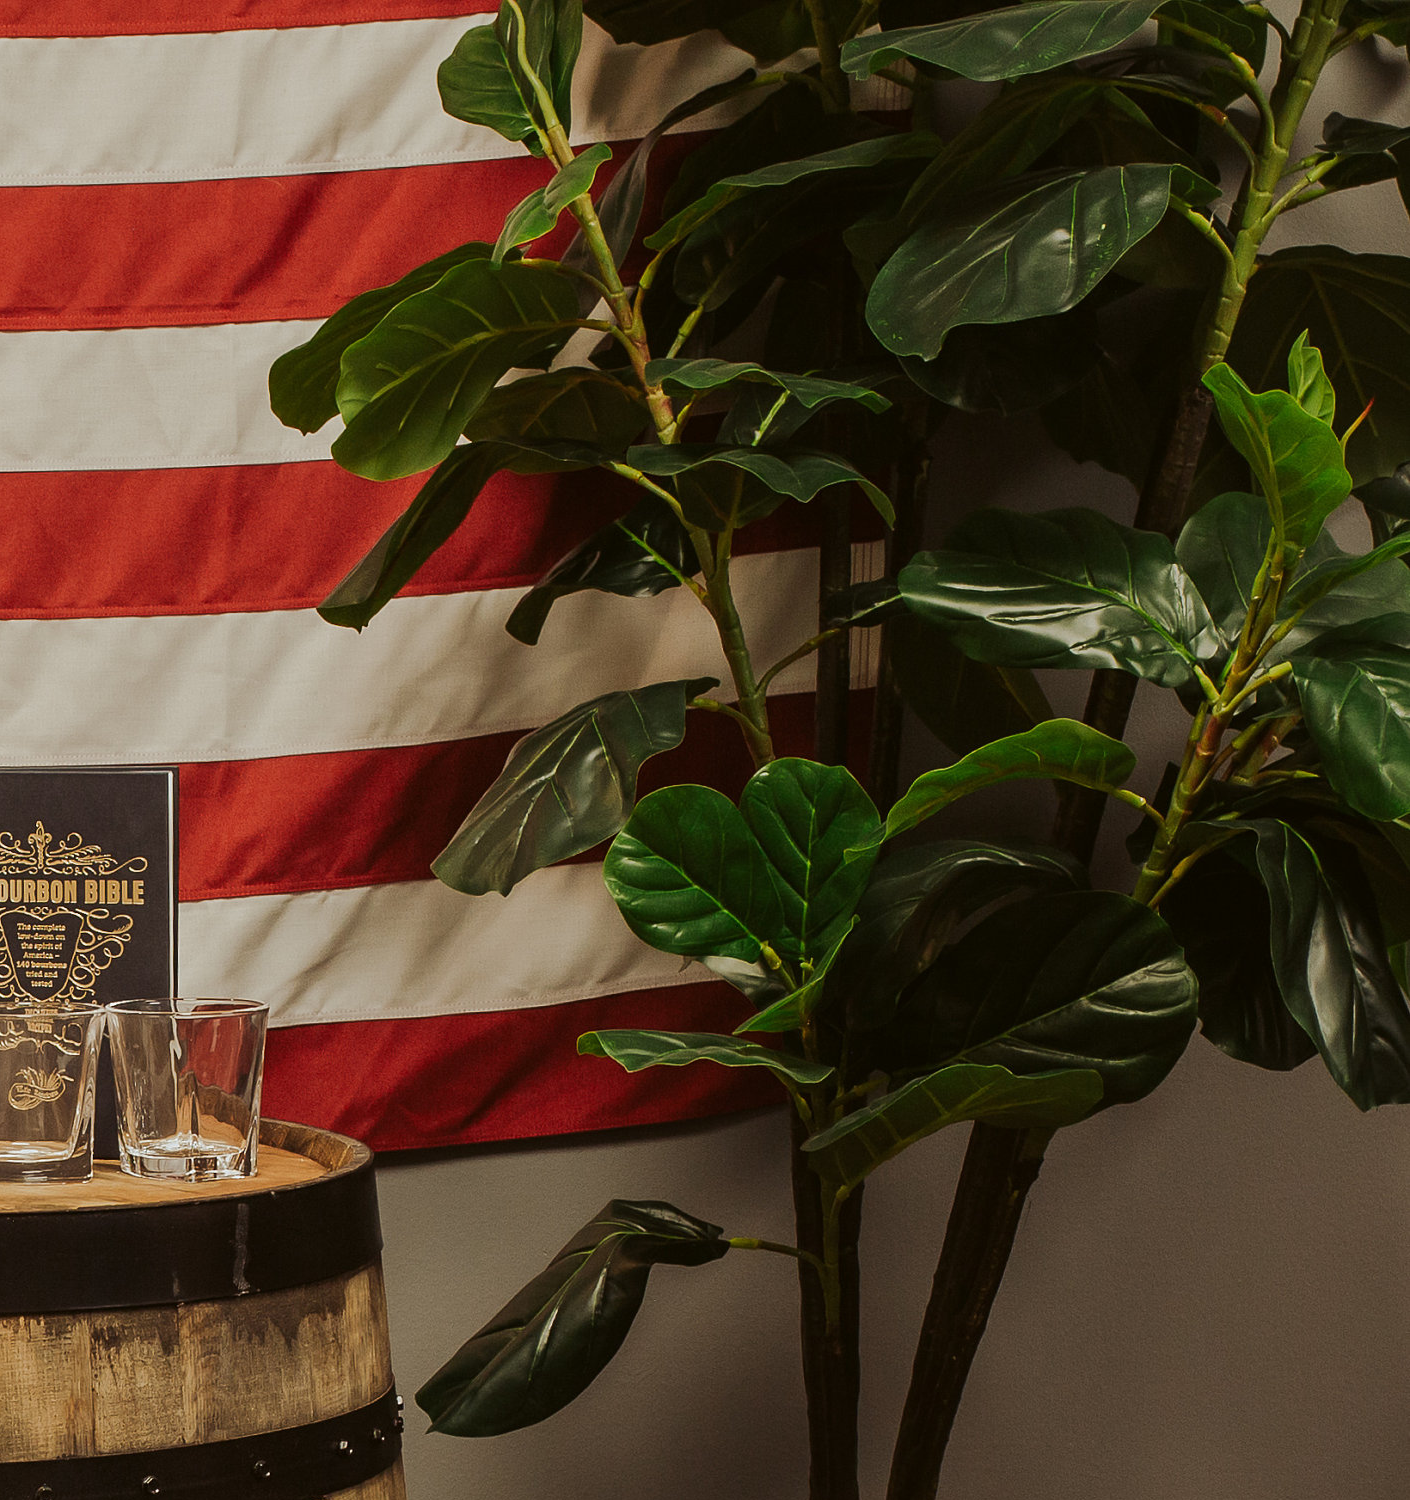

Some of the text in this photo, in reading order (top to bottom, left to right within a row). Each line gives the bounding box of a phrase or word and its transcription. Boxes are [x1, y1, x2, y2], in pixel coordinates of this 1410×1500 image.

[84, 880, 144, 905] BIBLE
[16, 922, 66, 932] The complete
[21, 941, 63, 951] the spirit of
[22, 951, 54, 959] America
[16, 960, 68, 969] 140 bourbons
[25, 970, 59, 978] tried and
[30, 980, 54, 988] tested
